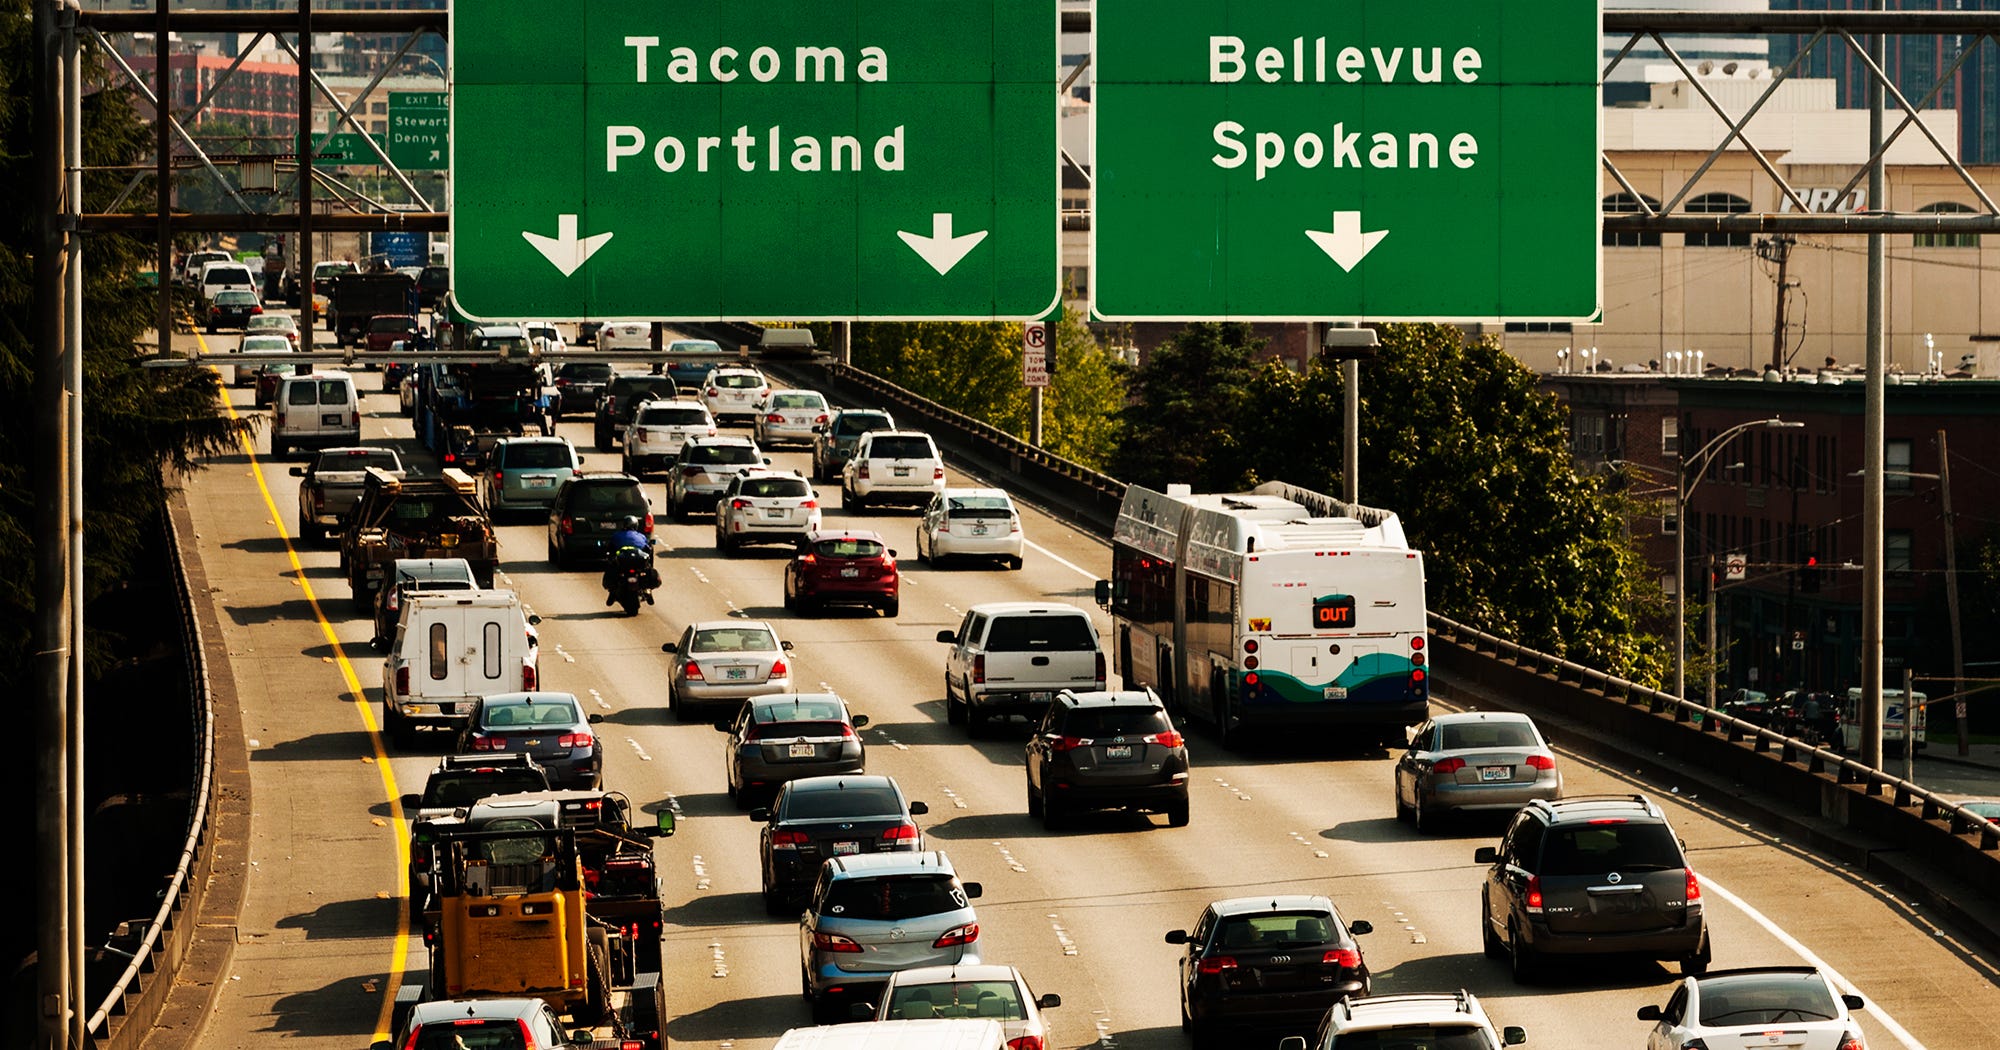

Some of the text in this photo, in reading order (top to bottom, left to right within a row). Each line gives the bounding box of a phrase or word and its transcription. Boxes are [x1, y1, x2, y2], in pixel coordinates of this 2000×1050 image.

[625, 37, 888, 83] Tacoma
[1209, 36, 1482, 83] Bellevue
[406, 96, 428, 104] EXIT
[395, 116, 448, 126] Stewart
[395, 133, 437, 144] Denny
[606, 125, 905, 173] Portland
[1211, 121, 1478, 180] Spokane
[1320, 607, 1349, 622] OUT
